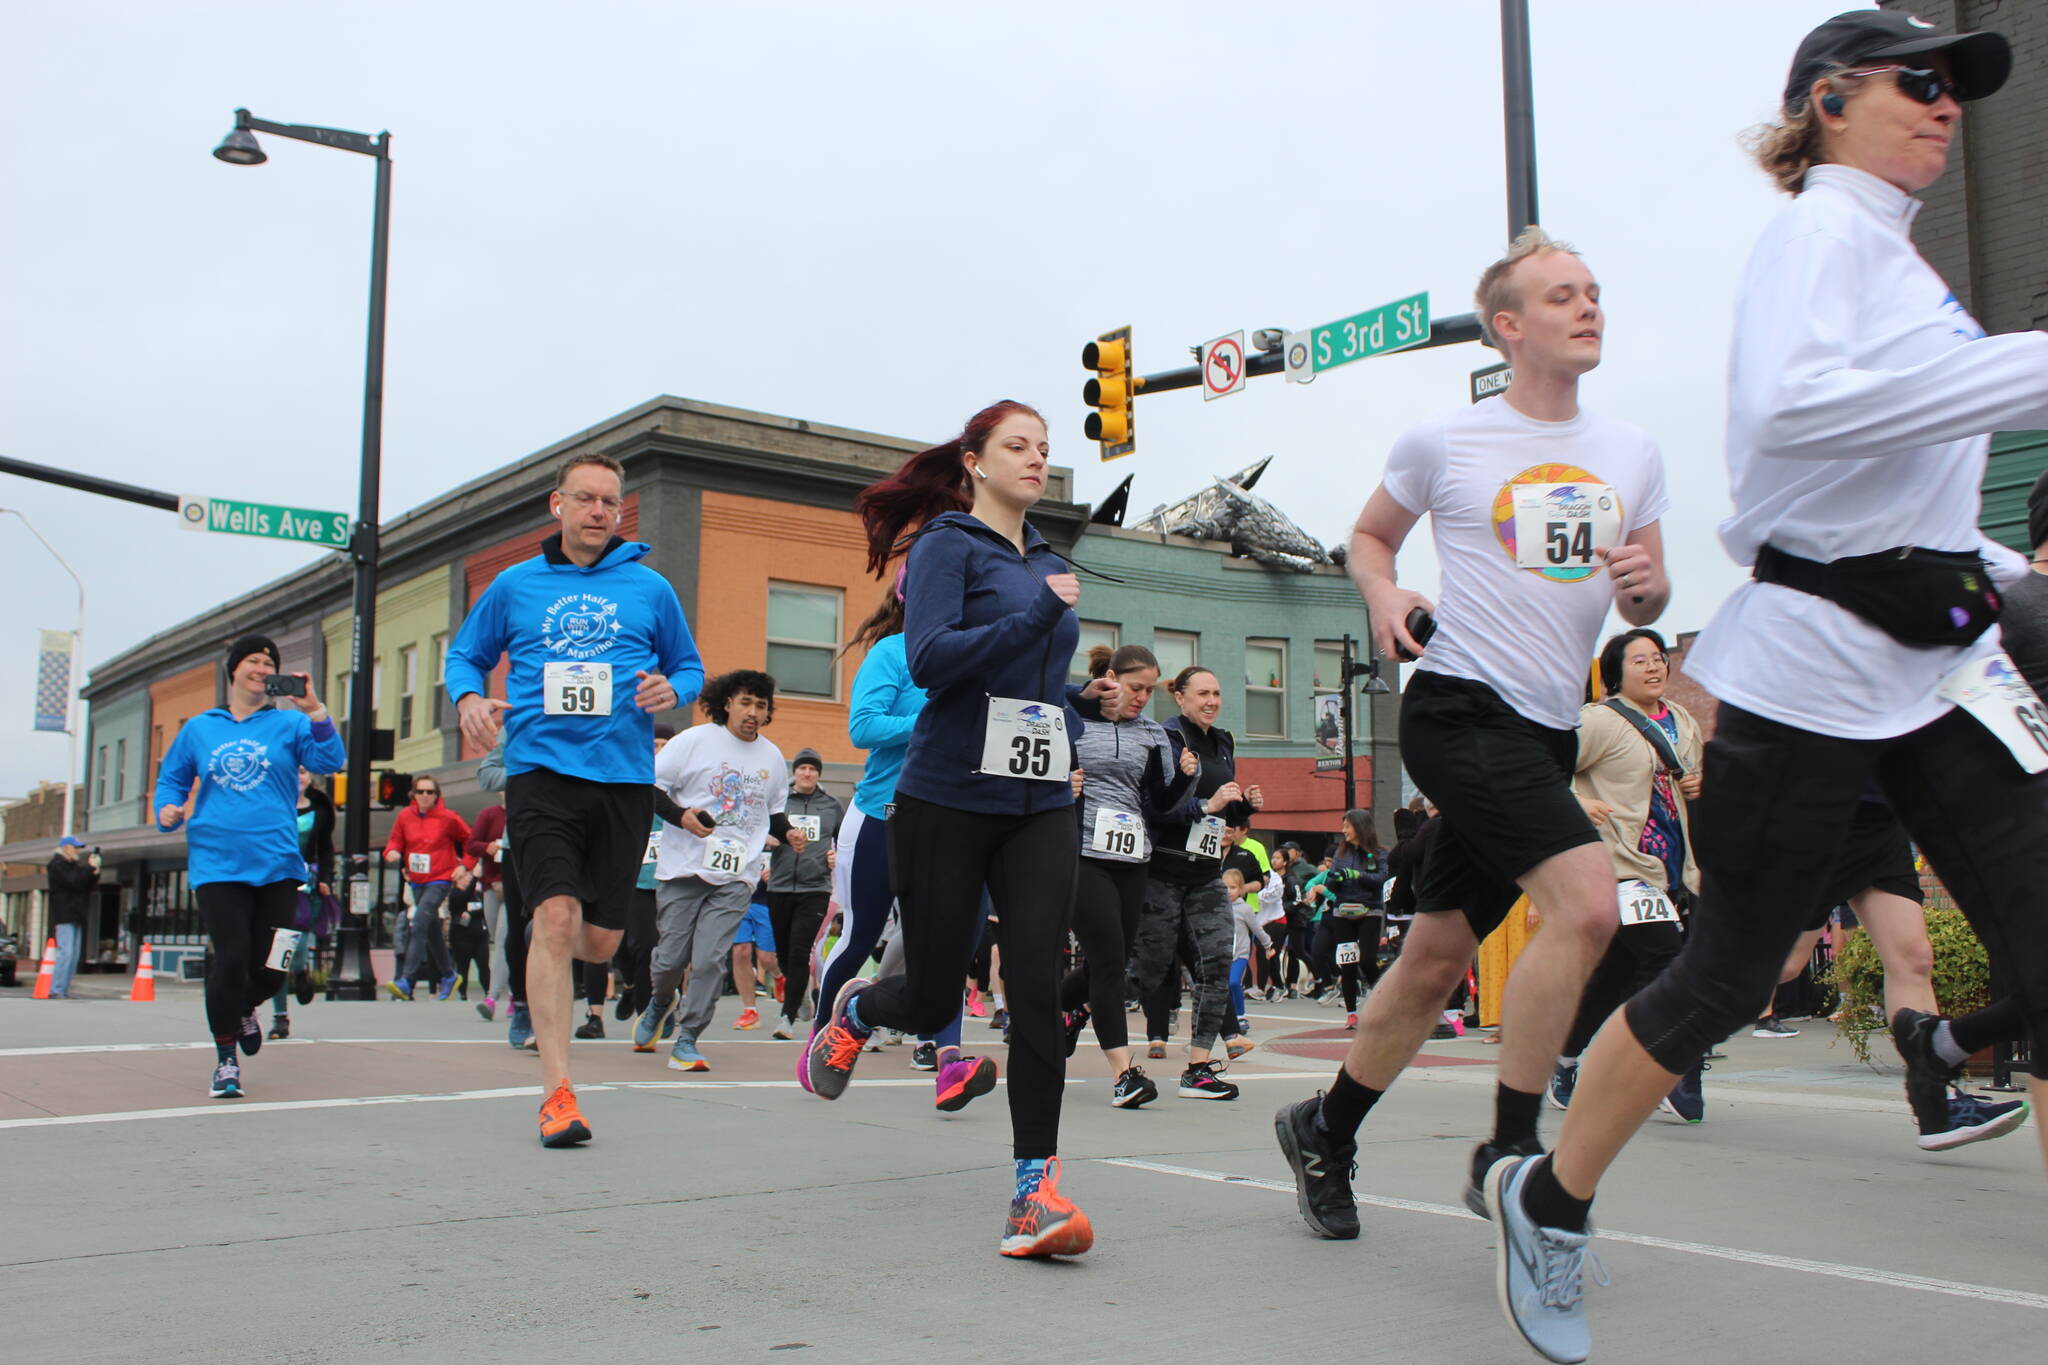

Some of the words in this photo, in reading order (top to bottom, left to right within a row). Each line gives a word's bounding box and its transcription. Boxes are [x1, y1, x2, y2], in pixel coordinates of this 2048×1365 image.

[1317, 329, 1332, 365] S
[1343, 312, 1384, 357] 3rd
[1396, 300, 1423, 341] St
[1478, 372, 1500, 392] ONE
[211, 501, 270, 534] Wells
[278, 510, 324, 540] Ave
[331, 515, 347, 543] S
[1566, 510, 1591, 518] DASH
[1546, 522, 1594, 564] 54
[546, 594, 578, 615] Better
[582, 593, 608, 606] Half
[541, 616, 555, 633] My
[567, 623, 590, 631] WITH
[569, 617, 588, 625] RUN
[570, 629, 584, 637] ME
[567, 635, 617, 659] Marathon
[562, 686, 595, 712] 59
[1031, 727, 1050, 736] DASH
[2014, 701, 2048, 757] 6
[1009, 735, 1051, 777] 35
[1105, 830, 1136, 854] 119
[1200, 833, 1218, 855] 45
[711, 850, 740, 873] 281
[1630, 898, 1669, 921] 124
[1340, 951, 1357, 963] 123
